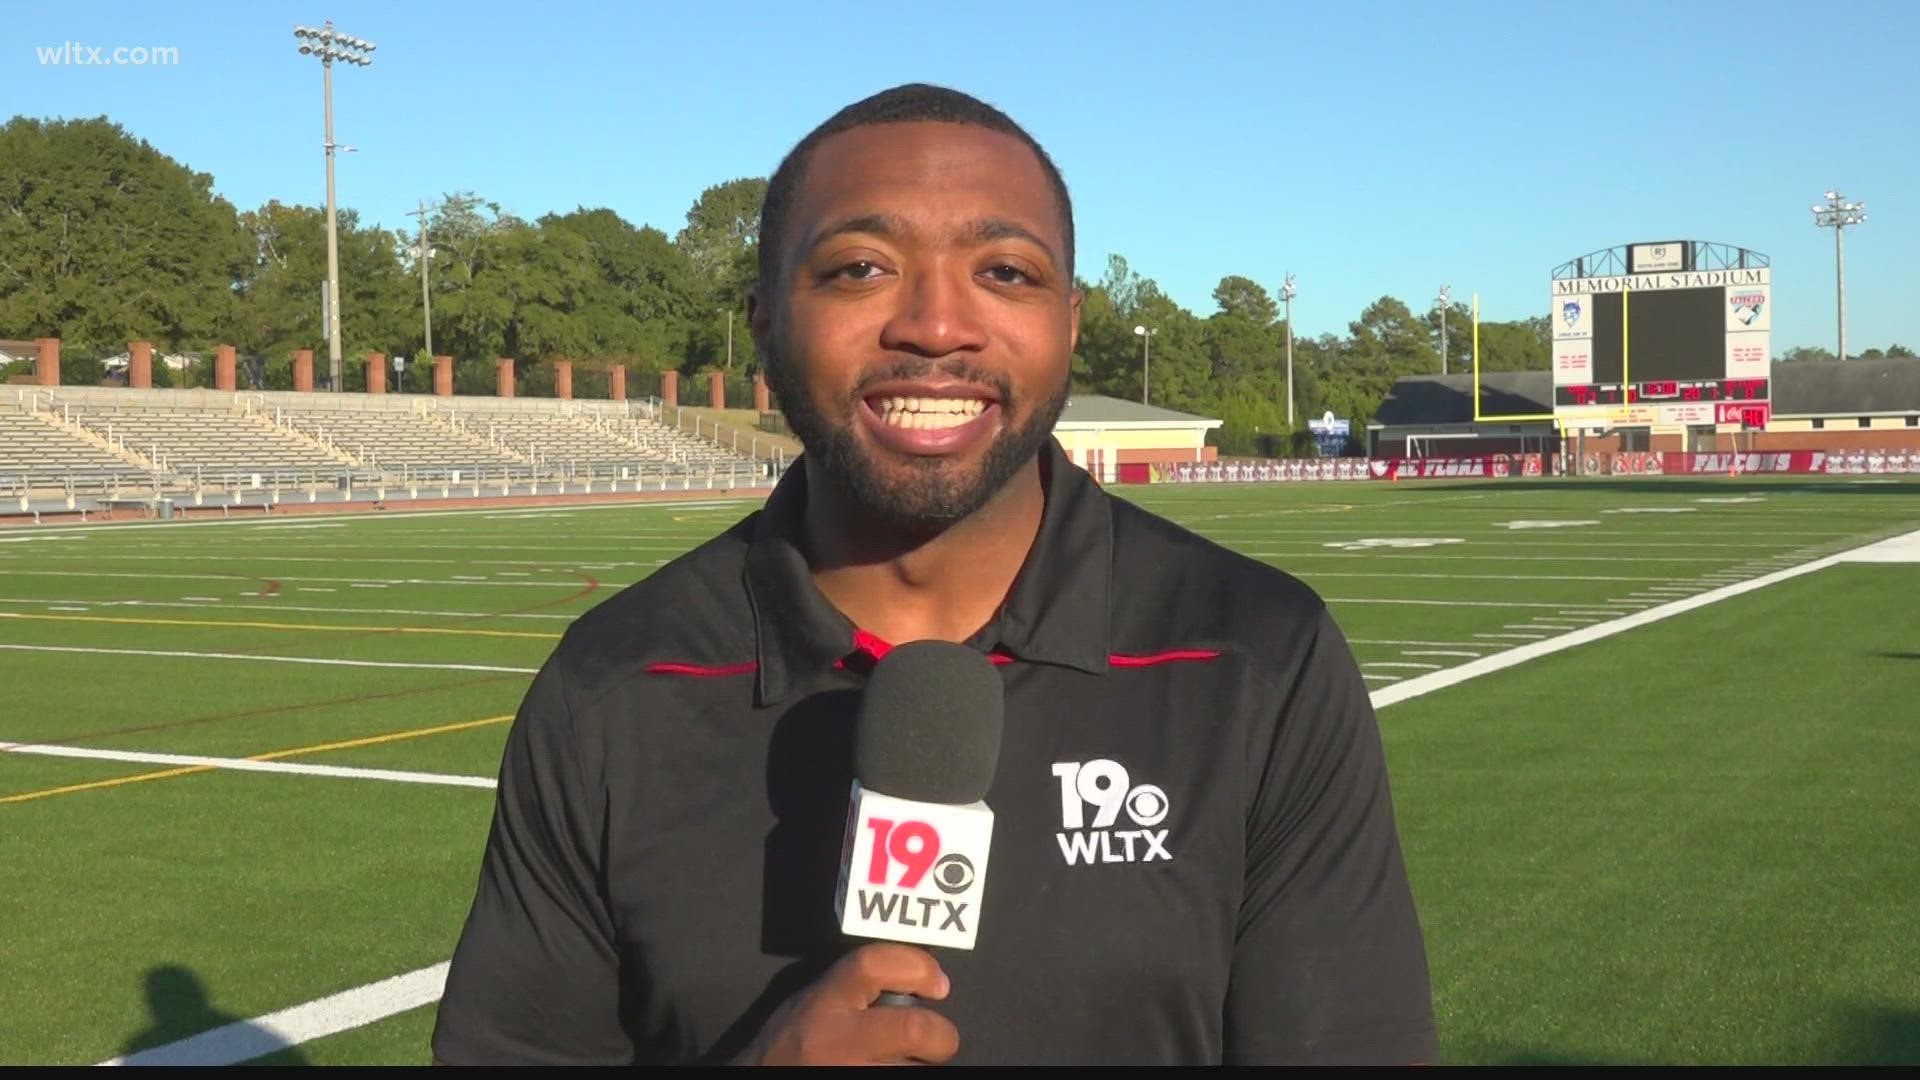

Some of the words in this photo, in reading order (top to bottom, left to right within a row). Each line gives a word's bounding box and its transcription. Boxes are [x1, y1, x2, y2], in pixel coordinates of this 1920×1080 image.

[1558, 275, 1666, 294] MEMORIAL
[1670, 270, 1762, 288] STADIUM
[1692, 453, 1792, 472] FALCONS
[1052, 758, 1130, 829] 19
[866, 817, 941, 890] 19
[1056, 829, 1173, 866] WLTX
[858, 889, 969, 933] WLTX
